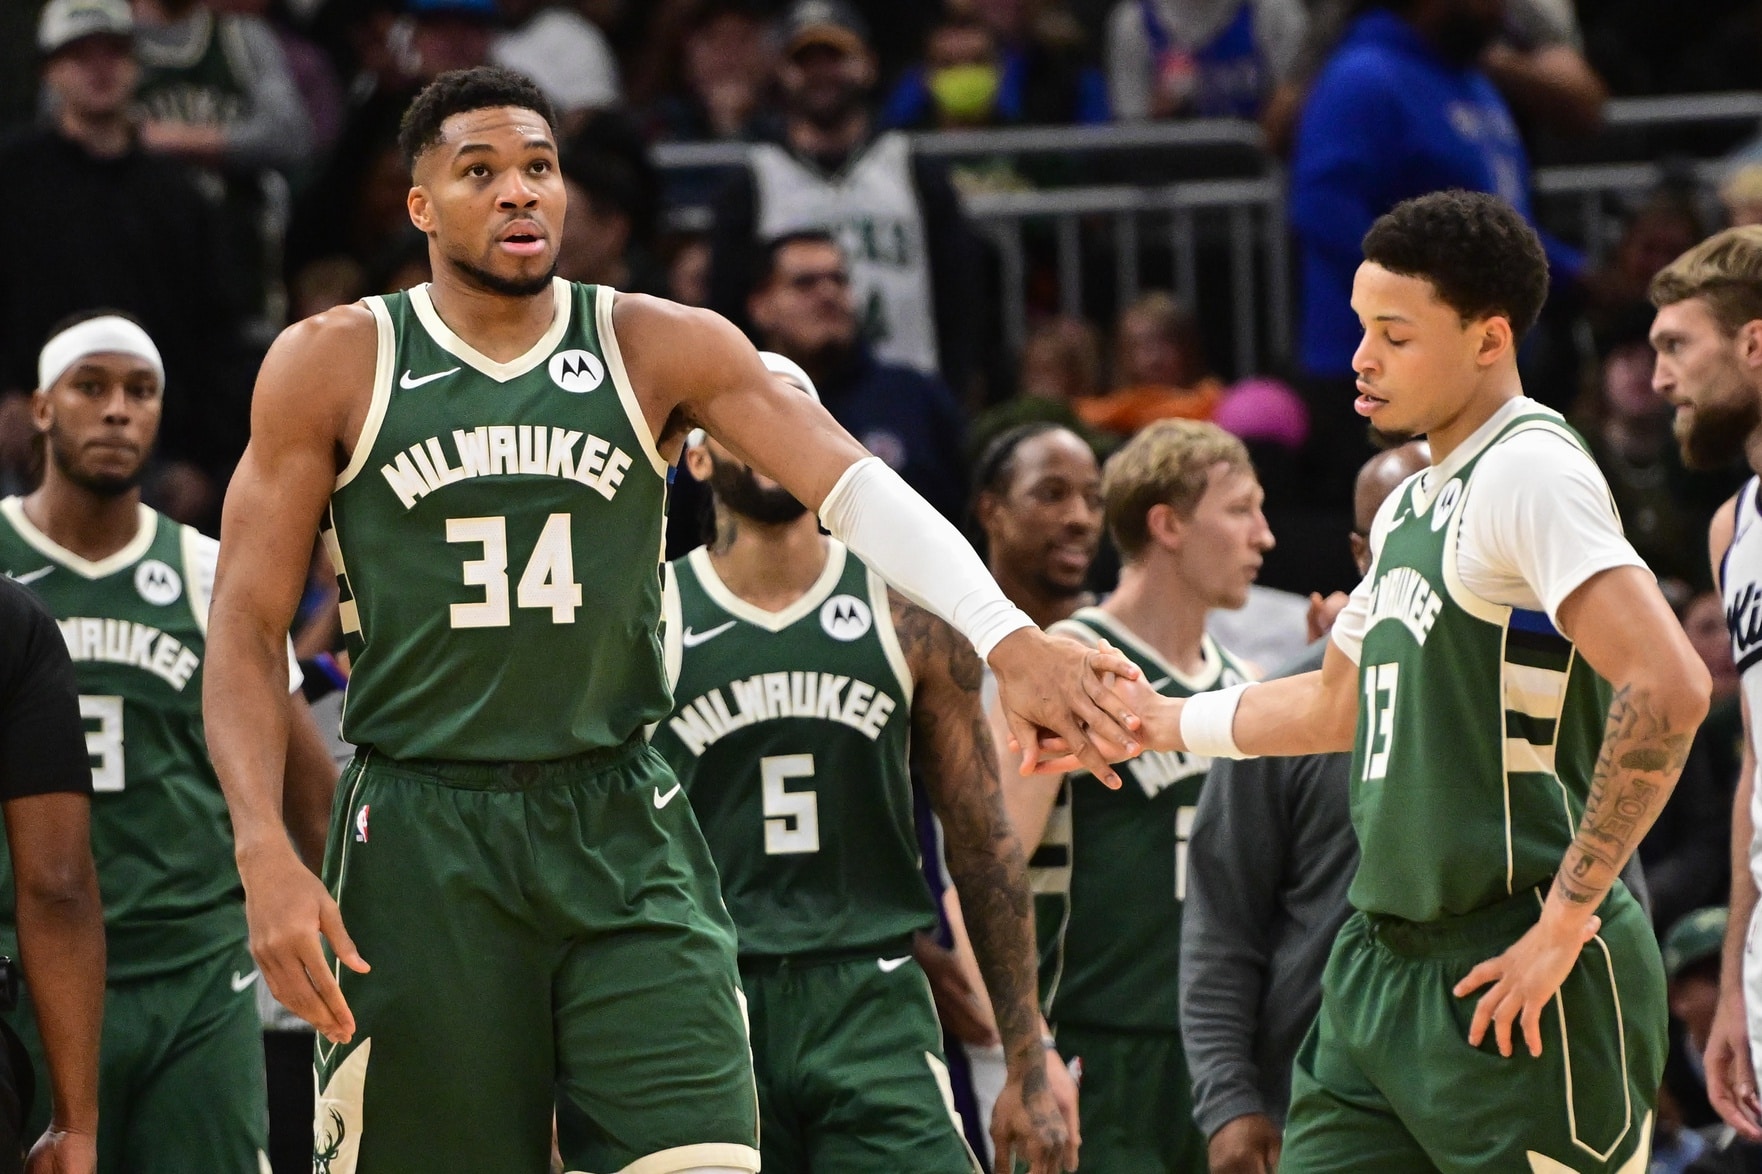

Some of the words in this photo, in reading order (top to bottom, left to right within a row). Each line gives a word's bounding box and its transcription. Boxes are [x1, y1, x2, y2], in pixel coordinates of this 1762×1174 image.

[380, 425, 633, 510] MILWAUKEE
[445, 513, 582, 629] 34
[78, 694, 126, 792] 3
[669, 671, 896, 757] MILWAUKEE
[1361, 662, 1399, 782] 13
[760, 753, 820, 855] 5
